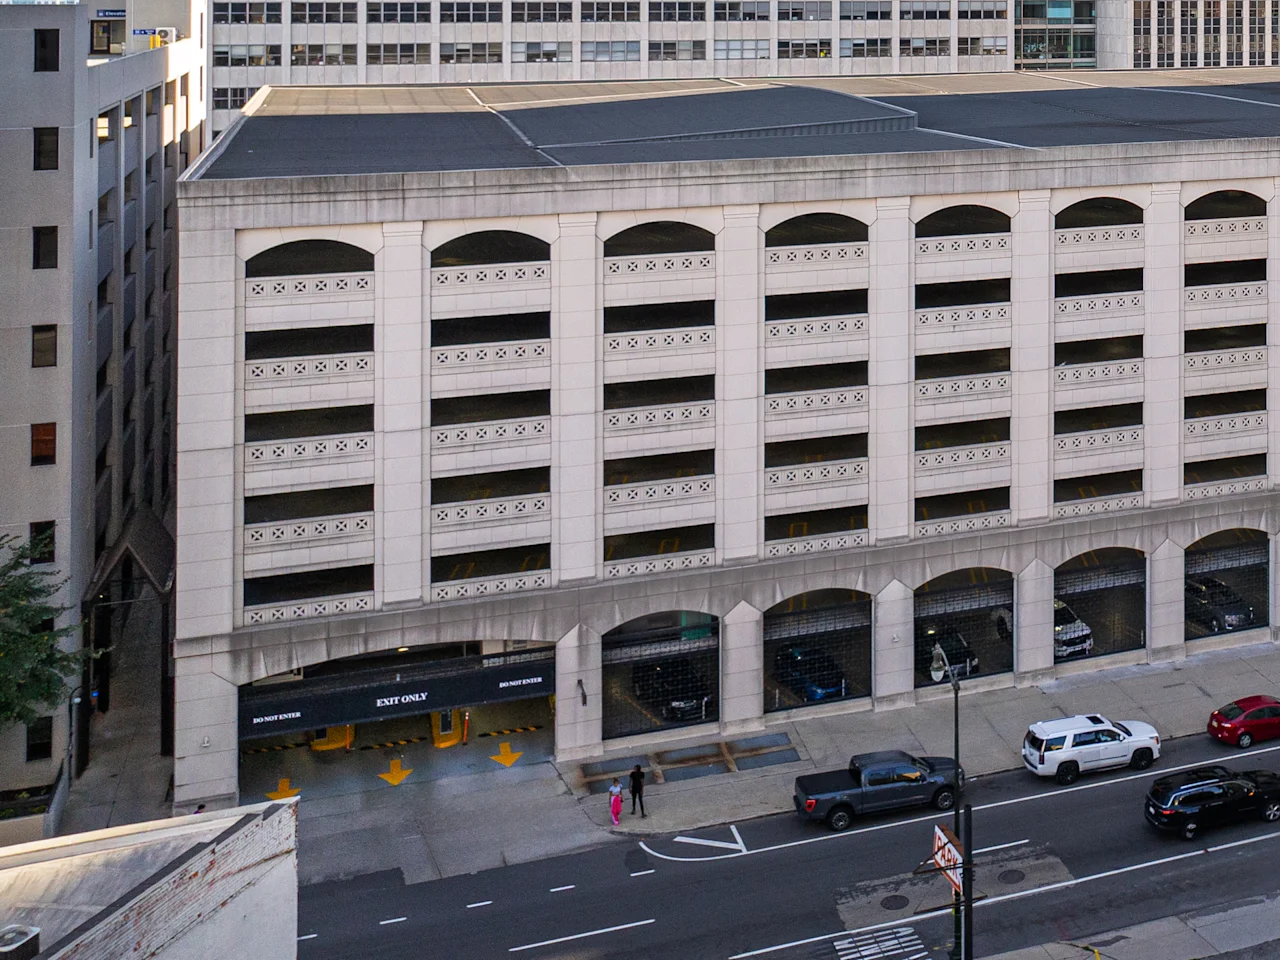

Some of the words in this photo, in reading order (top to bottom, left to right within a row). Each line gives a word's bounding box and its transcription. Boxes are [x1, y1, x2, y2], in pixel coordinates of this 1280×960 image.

[522, 677, 543, 686] ENTER
[376, 696, 400, 707] EXIT
[401, 692, 428, 705] ONLY
[279, 711, 301, 720] ENTER
